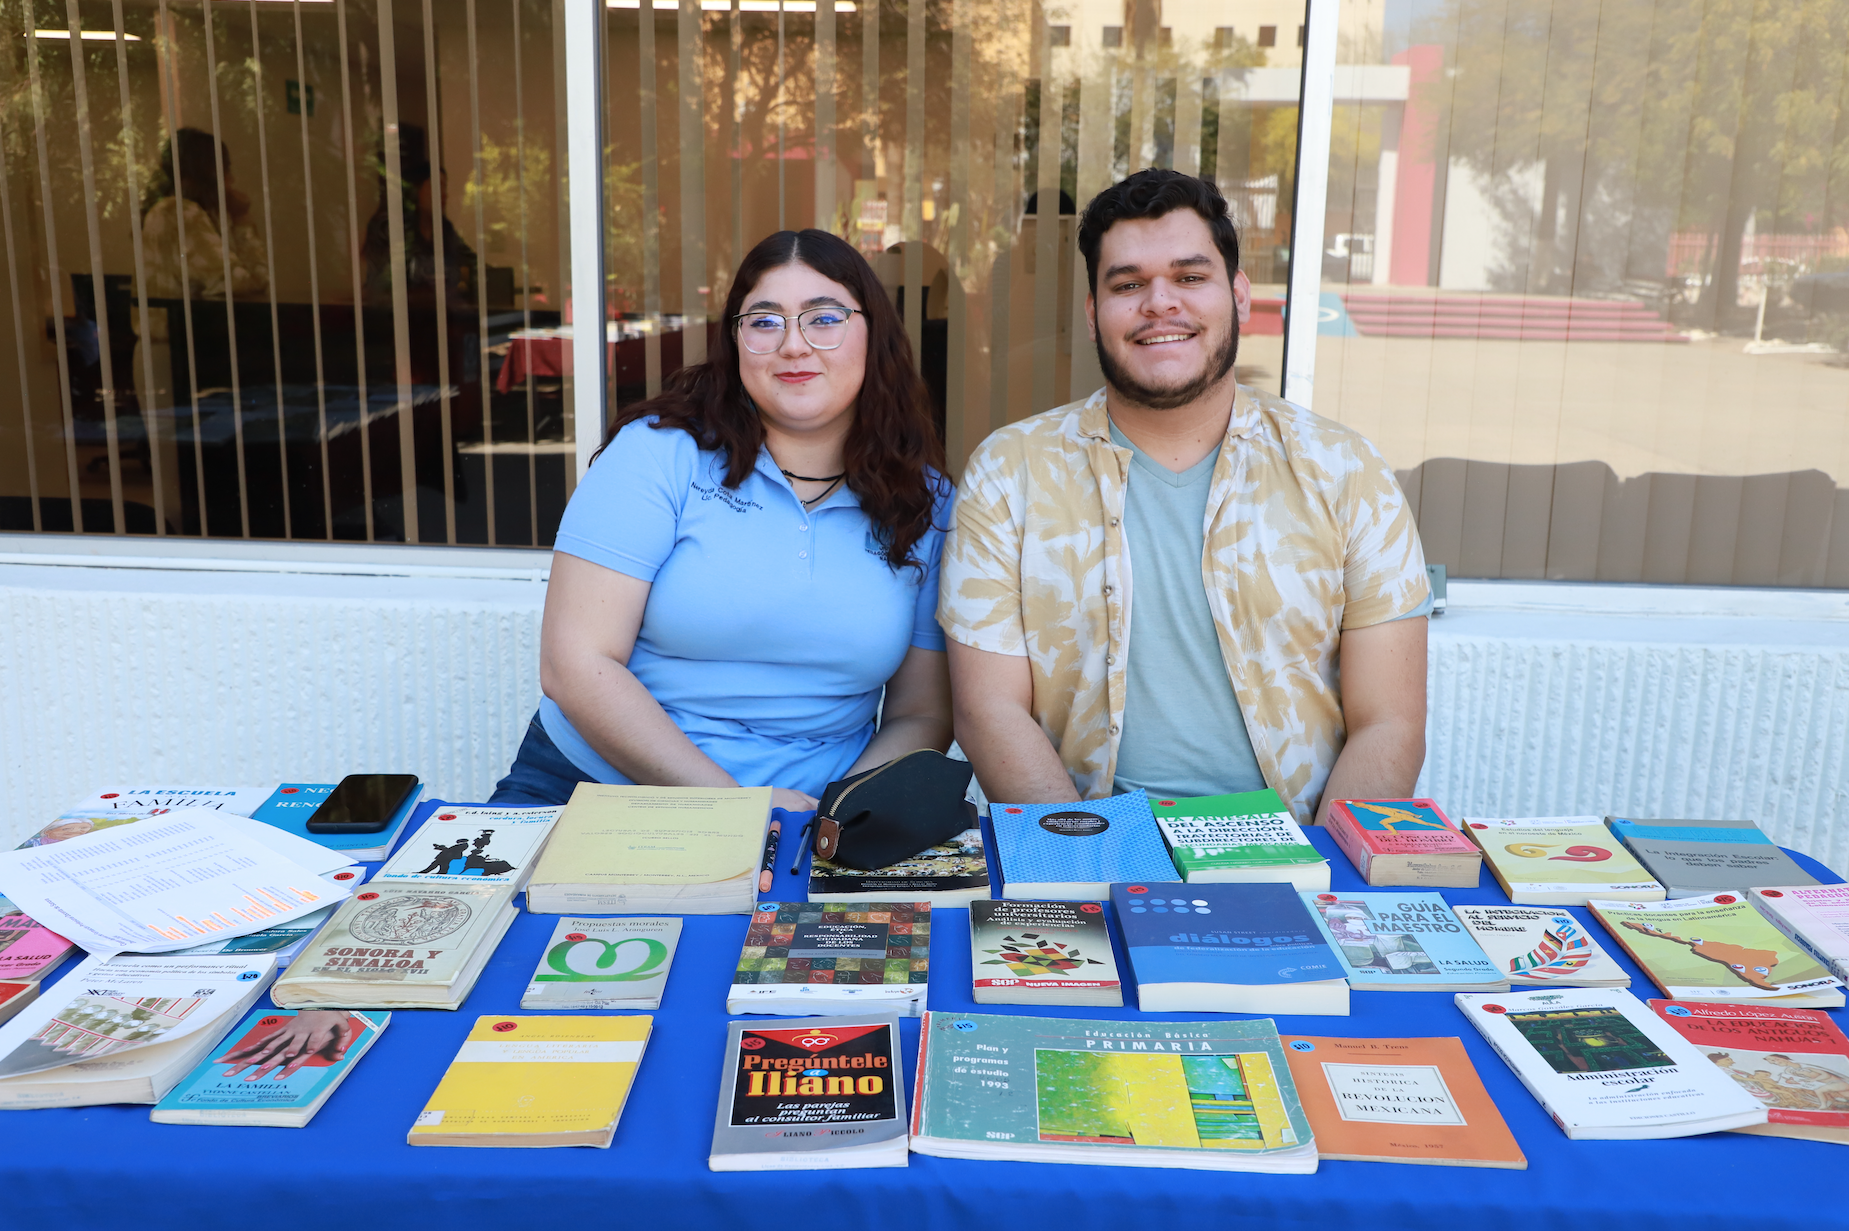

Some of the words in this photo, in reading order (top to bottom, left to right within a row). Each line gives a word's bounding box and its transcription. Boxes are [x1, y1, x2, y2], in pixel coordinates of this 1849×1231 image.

[112, 798, 225, 810] FAMILIA
[1167, 821, 1198, 829] DEL
[1203, 818, 1285, 828] ASCENSO
[1208, 825, 1289, 833] DIRECCIÓN.
[1174, 831, 1272, 840] TRAYECTORIAS
[1664, 850, 1728, 858] Integración
[1397, 900, 1446, 913] GUÍA
[1706, 905, 1747, 914] enseñanza
[993, 911, 1078, 919] universitarios
[1378, 913, 1426, 922] PARA
[1431, 913, 1454, 923] EL
[571, 920, 626, 928] Propuestas
[1372, 922, 1461, 933] MAESTRO
[1169, 933, 1310, 947] diálogos
[323, 947, 414, 959] SONORA
[427, 950, 443, 959] Y
[325, 957, 425, 969] SINALOA
[1787, 979, 1834, 990] SONORA
[1693, 1008, 1737, 1017] Alfredo
[1739, 1009, 1776, 1020] López
[1780, 1013, 1819, 1022] Austin
[496, 1023, 514, 1031] $10
[956, 1020, 973, 1029] $15
[1706, 1019, 1726, 1027] LA
[1730, 1019, 1825, 1031] EDUCACIÓN
[1085, 1030, 1151, 1039] Educación
[1165, 1031, 1210, 1039] Básica
[1686, 1023, 1708, 1031] DE
[1711, 1025, 1742, 1034] LOS
[1747, 1028, 1830, 1038] ANTIGUOS
[744, 1039, 761, 1048] $15
[1086, 1039, 1213, 1051] PRIMARIA
[1754, 1035, 1822, 1044] NAHUAS
[1829, 1037, 1837, 1045] 1
[976, 1043, 999, 1052] Plan
[1002, 1046, 1009, 1054] y
[742, 1053, 888, 1073] Pregúntele
[953, 1055, 1009, 1066] programas
[954, 1066, 967, 1074] de
[970, 1068, 1009, 1077] estudio
[1566, 1066, 1679, 1082] Administración
[746, 1070, 883, 1097] Iliano
[980, 1079, 1009, 1090] 1993
[1352, 1078, 1420, 1086] HISTORICA
[1601, 1076, 1655, 1086] escolar
[1342, 1092, 1446, 1104] REVOLUCION
[1599, 1091, 1659, 1100] administración
[1661, 1088, 1696, 1097] enfocada
[776, 1102, 801, 1110] Las
[802, 1101, 850, 1111] parejas
[1356, 1104, 1443, 1115] MEXICANA
[745, 1115, 760, 1123] al
[762, 1113, 823, 1122] consultor
[822, 1112, 881, 1123] familiar
[778, 1108, 847, 1117] preguntan
[765, 1129, 812, 1138] ILIANO
[813, 1128, 865, 1138] PICCOLO
